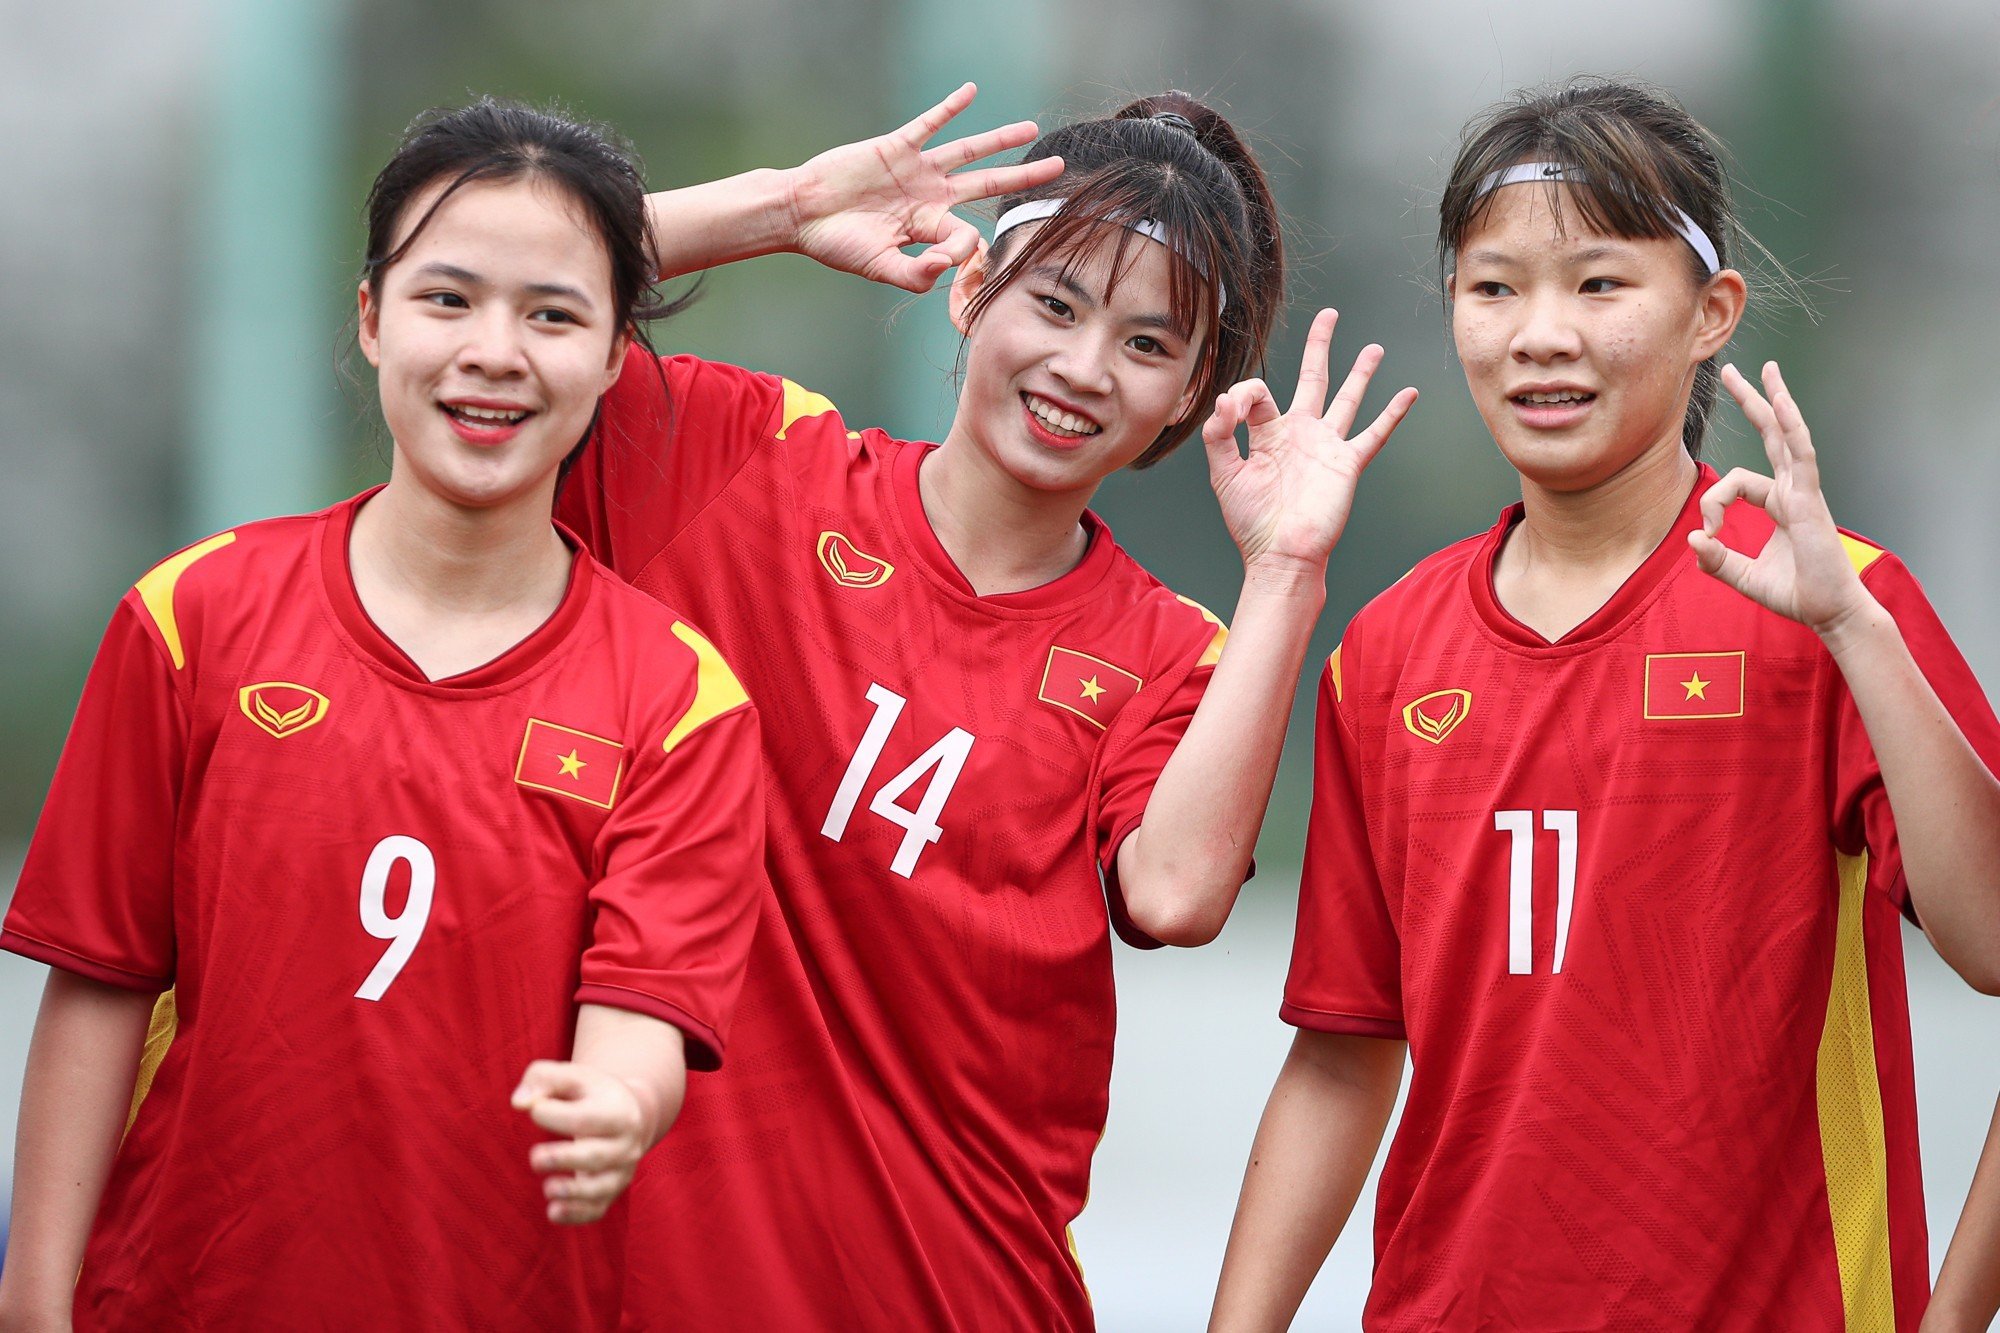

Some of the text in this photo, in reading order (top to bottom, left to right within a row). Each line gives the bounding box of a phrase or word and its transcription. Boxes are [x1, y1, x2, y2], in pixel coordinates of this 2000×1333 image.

[820, 681, 976, 880] 14
[353, 835, 437, 1002] 9
[1494, 809, 1579, 976] 11
